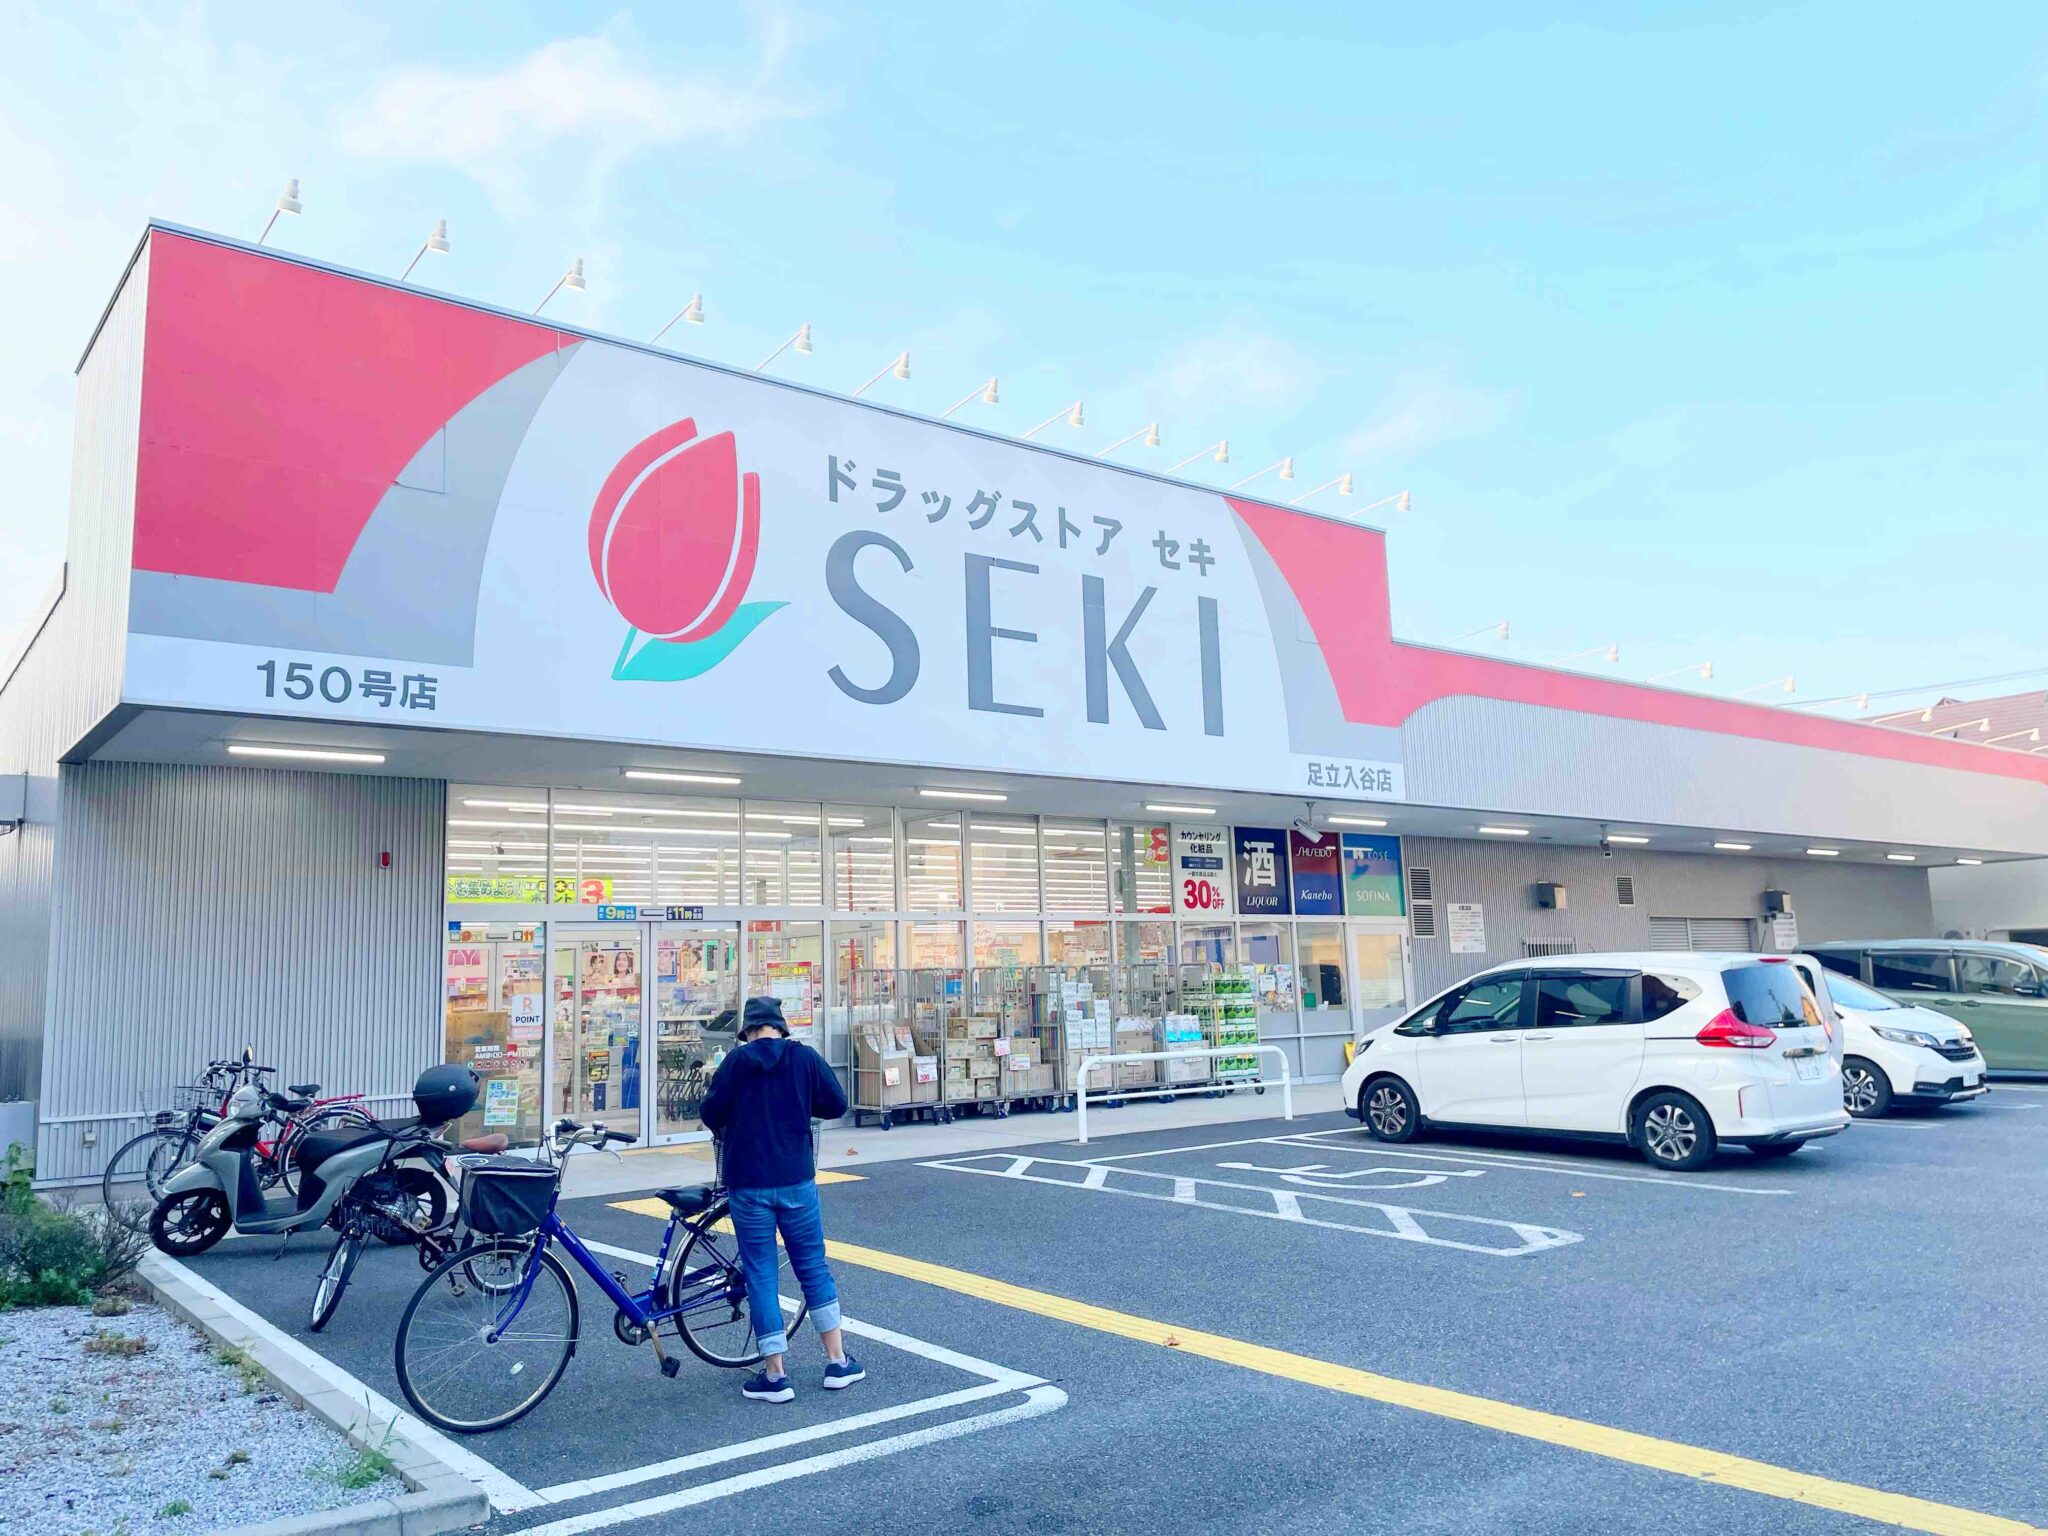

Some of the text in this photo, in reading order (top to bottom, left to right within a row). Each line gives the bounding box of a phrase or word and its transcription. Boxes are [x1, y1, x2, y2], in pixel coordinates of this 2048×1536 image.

[828, 454, 1216, 577] ドラッグストア セキ
[825, 529, 1224, 737] SEKI
[256, 660, 438, 711] 150号店
[1307, 762, 1392, 792] 足立入谷店
[1180, 830, 1222, 842] カウンセリング
[1190, 843, 1213, 854] 化粧品
[1295, 846, 1332, 858] SHISEIDO
[1242, 840, 1276, 887] 酒
[1246, 895, 1279, 908] LIQUOR
[1300, 889, 1333, 901] Kanebo
[1355, 889, 1391, 902] SOFINA
[1212, 898, 1225, 910] OFF
[515, 1015, 541, 1024] POINT
